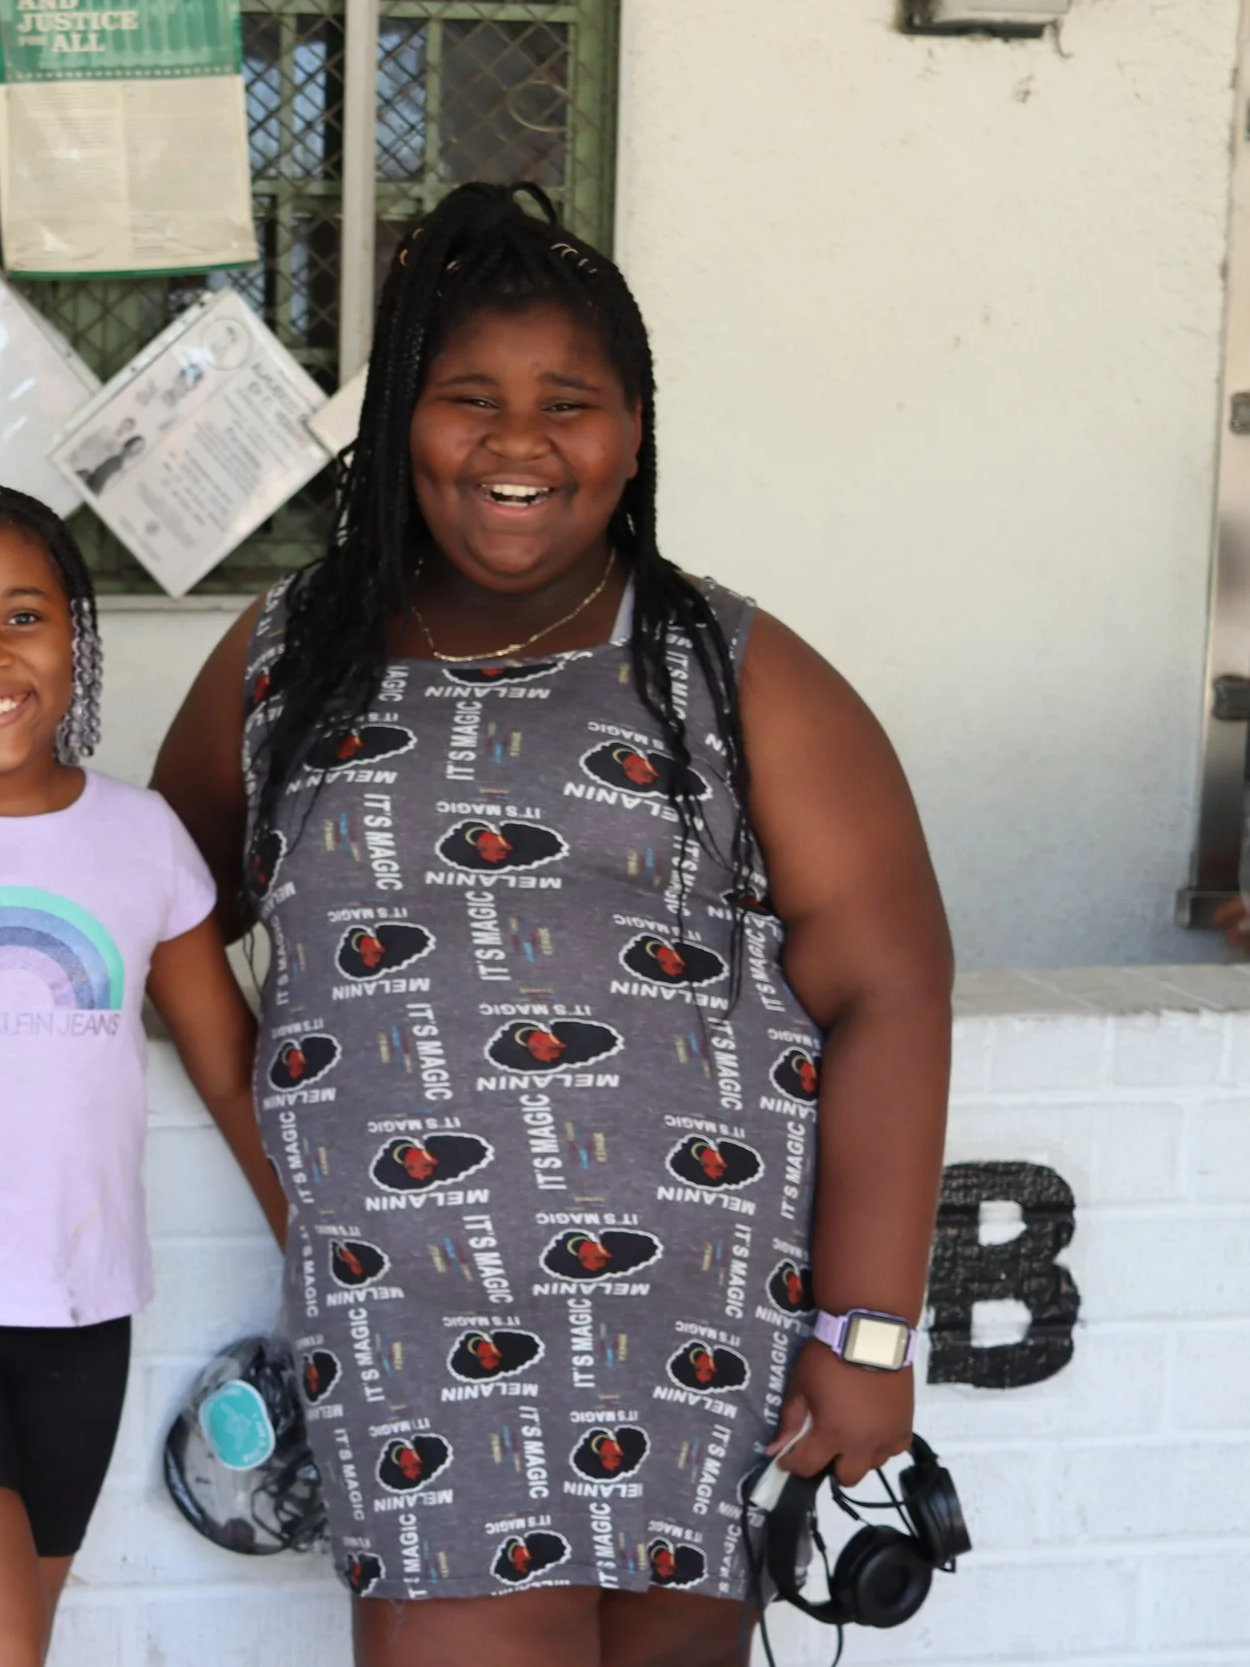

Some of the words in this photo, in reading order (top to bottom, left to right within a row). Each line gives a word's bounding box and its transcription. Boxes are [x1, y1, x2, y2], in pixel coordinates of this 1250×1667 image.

[18, 0, 79, 10] AND
[17, 10, 139, 32] JUSTICE
[51, 32, 106, 52] ALL
[424, 685, 551, 699] MELANIN
[452, 700, 483, 748] MAGIC
[588, 721, 649, 745] MAGIC
[445, 750, 478, 780] IT'S
[286, 769, 398, 795] MELANN
[363, 793, 393, 827] IT'S
[436, 801, 501, 816] MAGIC
[505, 805, 541, 819] IT'S
[364, 831, 403, 890] MAGIC
[424, 871, 562, 889] MELANIN
[327, 907, 374, 922] MAGIC
[377, 907, 408, 918] IT'S
[465, 890, 503, 946] MAGIC
[613, 914, 671, 935] MAGIC
[476, 949, 512, 981] IT'S
[332, 978, 431, 1000] MELANIN
[610, 980, 729, 1010] MELANIN
[406, 1003, 439, 1036] IT'S
[478, 1003, 549, 1016] MAGIC
[552, 1004, 592, 1016] IT'S
[57, 1013, 121, 1036] JEANS
[707, 1017, 736, 1050] IT'S
[415, 1040, 454, 1101] MAGIC
[476, 1074, 619, 1092] MELANIN
[714, 1051, 743, 1111] MAGIC
[519, 1093, 560, 1153] MAGIC
[759, 1096, 818, 1123] LANIN
[367, 1119, 422, 1133] MAGIC
[426, 1117, 461, 1130] IT'S
[664, 1115, 718, 1133] MAGIC
[719, 1124, 746, 1138] IT'S
[279, 1111, 302, 1170] MAGIC
[785, 1121, 806, 1185] MAGIC
[533, 1157, 567, 1190] IT'S
[294, 1171, 315, 1204] IT'S
[365, 1188, 490, 1211] MELANIN
[656, 1186, 756, 1216] MELANIN
[780, 1185, 799, 1220] IT'S
[462, 1215, 497, 1249] IT'S
[535, 1213, 601, 1225] MAGIC
[604, 1213, 638, 1225] IT'S
[732, 1223, 753, 1258] IT'S
[472, 1252, 513, 1304] MAGIC
[926, 1161, 1081, 1389] B
[303, 1260, 320, 1318] MAGIC
[326, 1286, 405, 1307] MELANIN
[532, 1282, 651, 1296] MELANIN
[725, 1259, 749, 1320] MAGIC
[443, 1316, 490, 1327] MAGIC
[491, 1316, 520, 1326] IT'S
[566, 1298, 594, 1351] MAGIC
[674, 1320, 718, 1340] MAGIC
[755, 1305, 811, 1338] ELANIN
[348, 1307, 374, 1366] MAGIC
[719, 1331, 741, 1347] IT'S
[572, 1355, 596, 1388] IT'S
[769, 1331, 789, 1393] MAGIC
[361, 1369, 385, 1402] IT'S
[440, 1382, 539, 1402] MELANIN
[617, 1410, 638, 1421] IT'S
[653, 1386, 739, 1419] MELANIN
[519, 1405, 543, 1438] IT'S
[570, 1410, 616, 1423] MAGIC
[708, 1423, 732, 1458] IT'S
[523, 1440, 549, 1499] MAGIC
[342, 1464, 365, 1521] MAGIC
[563, 1481, 643, 1498] ELANIN
[693, 1458, 722, 1515] MAGIC
[373, 1489, 454, 1512] MELANIN
[485, 1518, 527, 1534] MAGIC
[528, 1515, 551, 1527] IT'S
[589, 1502, 617, 1559] MAGIC
[648, 1521, 683, 1538] MAGIC
[399, 1513, 421, 1573] MAGIC
